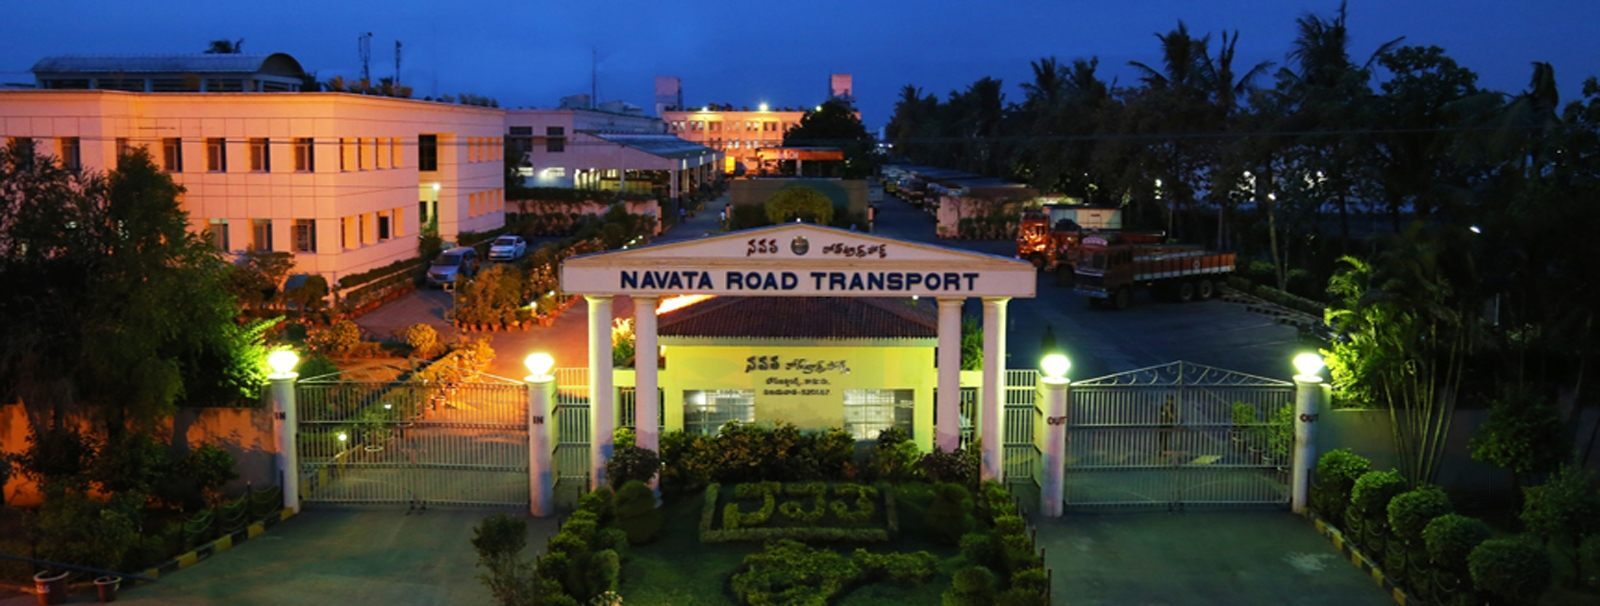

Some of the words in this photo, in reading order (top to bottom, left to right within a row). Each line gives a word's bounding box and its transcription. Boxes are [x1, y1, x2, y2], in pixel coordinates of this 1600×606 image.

[746, 238, 778, 257] నవత
[620, 271, 713, 290] NAVATA
[725, 271, 799, 291] ROAD
[810, 272, 980, 292] TRANSPORT
[745, 354, 780, 373] నవత
[275, 411, 286, 420] IN
[533, 415, 544, 425] IN
[1047, 415, 1067, 426] OUT
